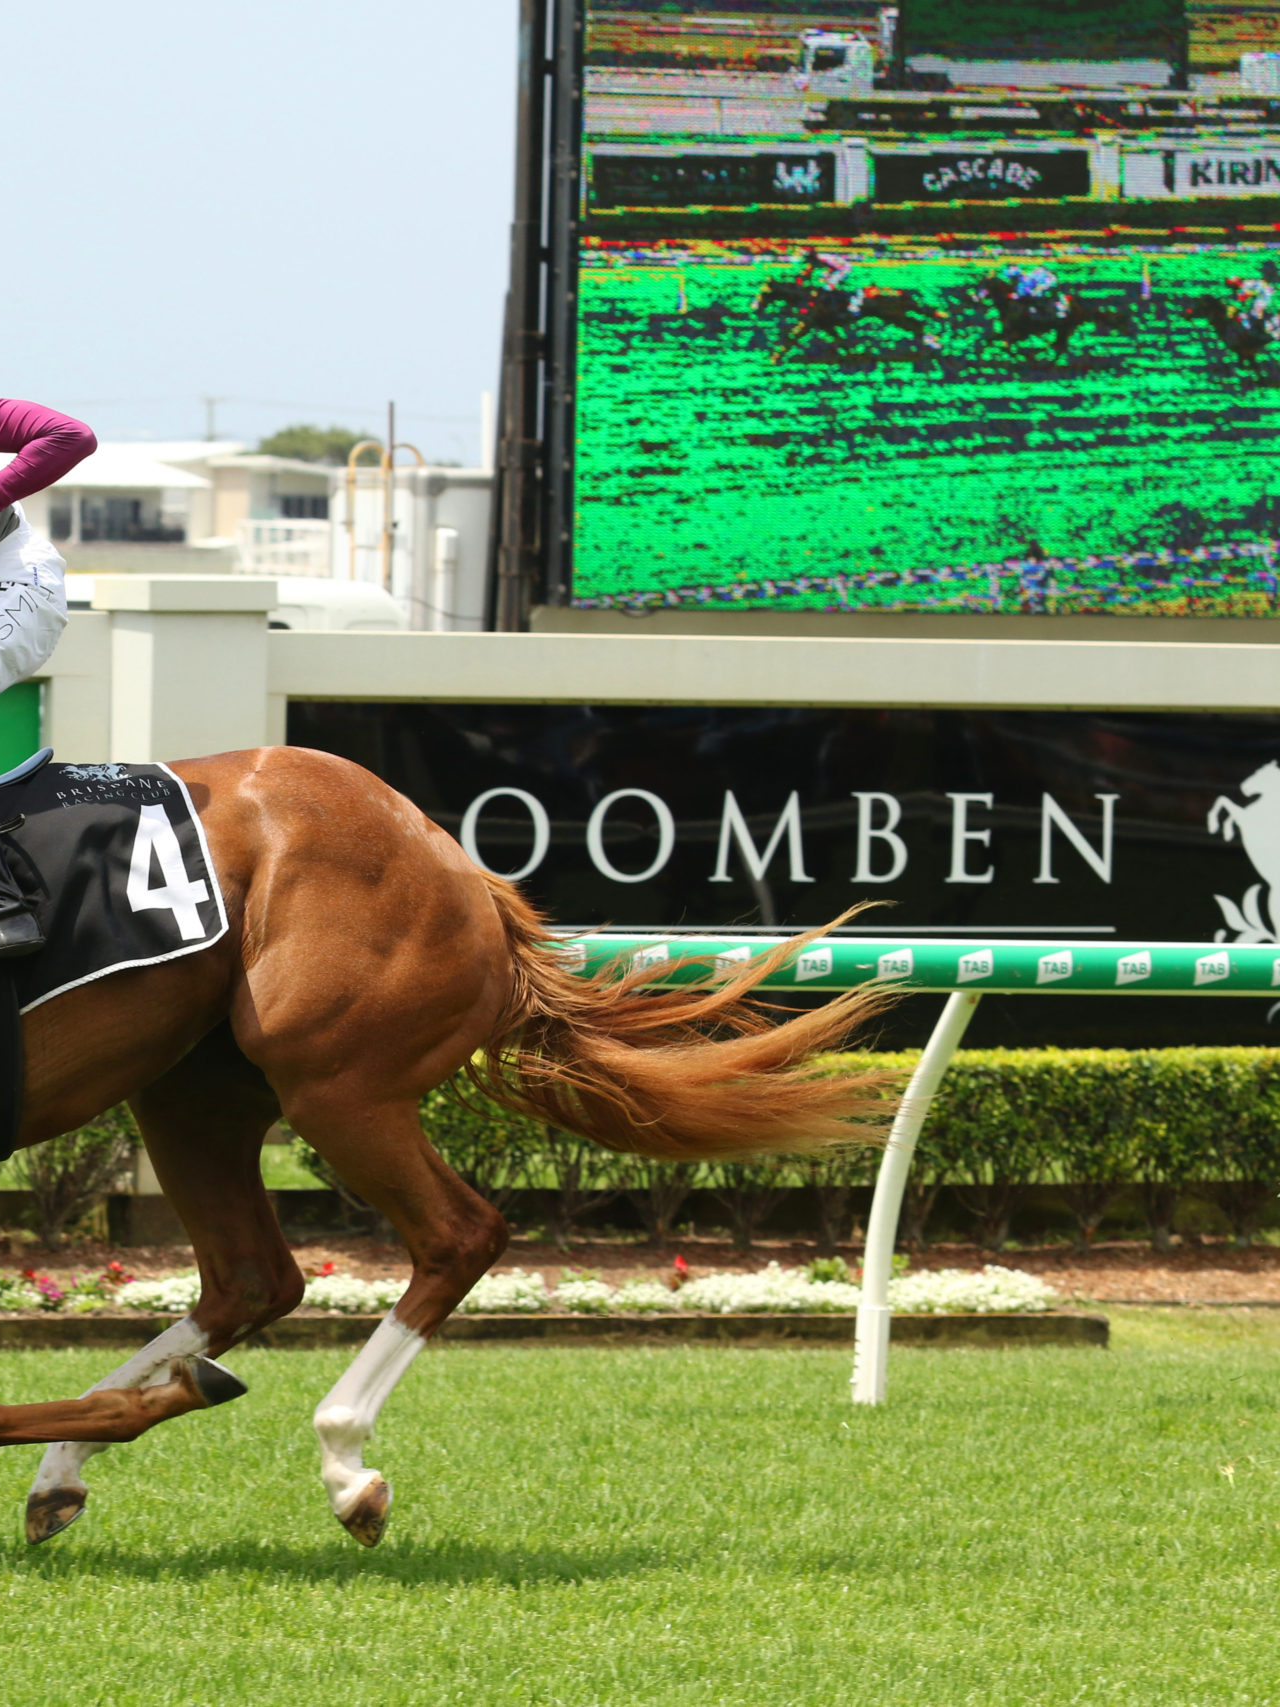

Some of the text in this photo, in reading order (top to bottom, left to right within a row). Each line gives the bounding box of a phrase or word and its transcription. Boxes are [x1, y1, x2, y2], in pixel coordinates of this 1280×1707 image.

[62, 787, 171, 809] RACING CLUB
[460, 786, 1120, 885] OOMBEN
[126, 803, 210, 941] 4
[801, 959, 828, 973] TAB
[883, 959, 909, 973] TAB
[963, 960, 989, 974] TAB
[1042, 961, 1068, 975] TAB
[1121, 962, 1147, 976] TAB
[1199, 962, 1225, 976] TAB
